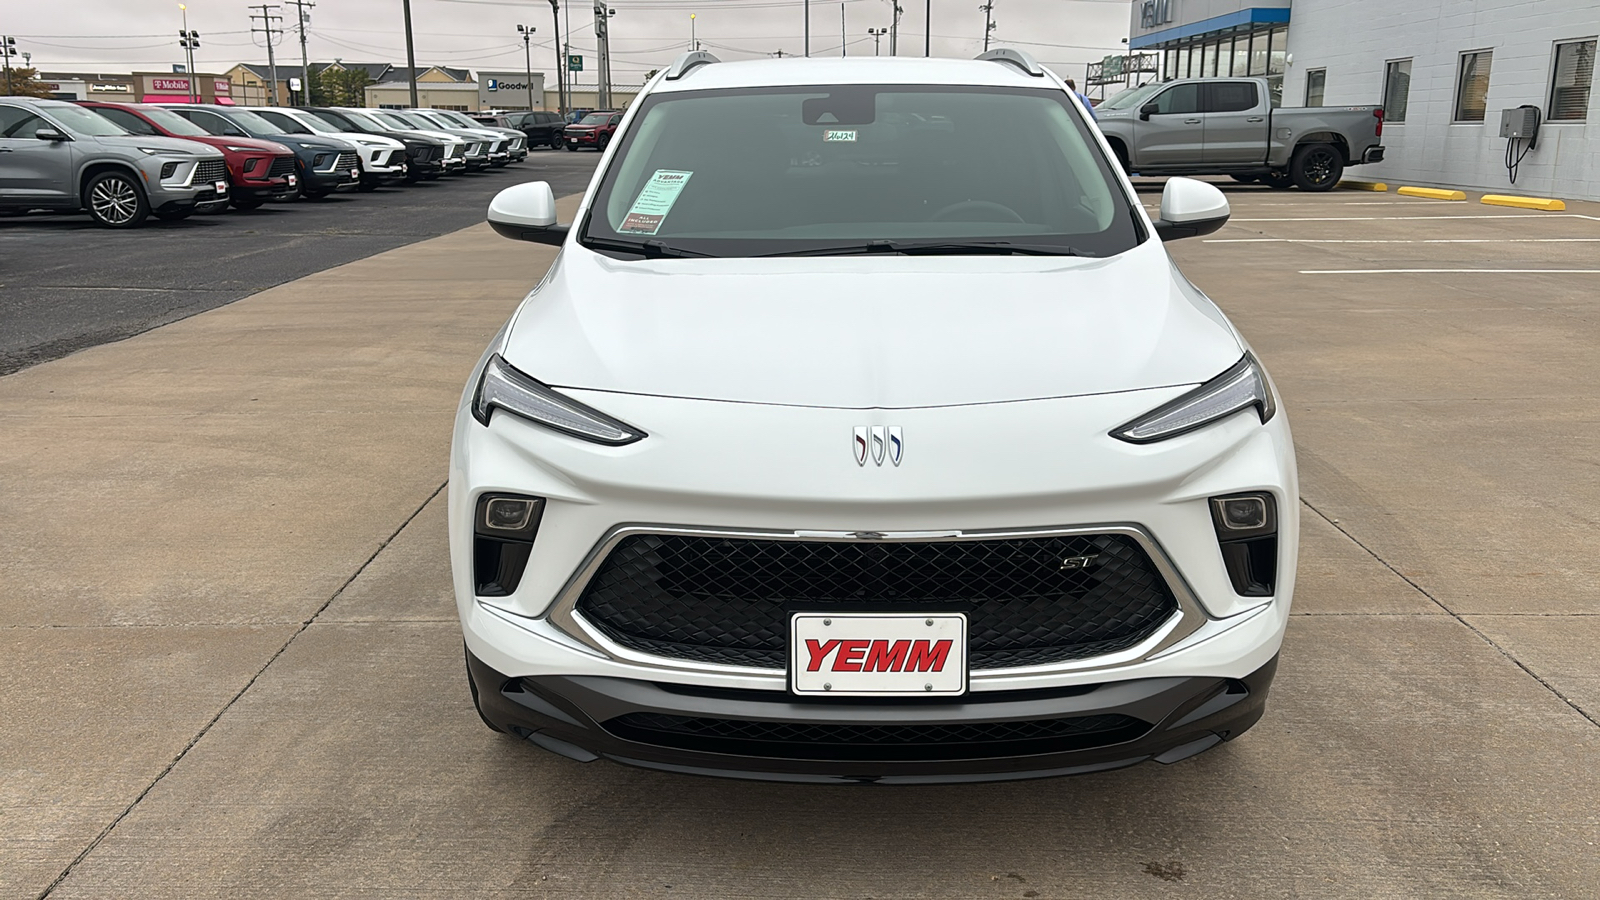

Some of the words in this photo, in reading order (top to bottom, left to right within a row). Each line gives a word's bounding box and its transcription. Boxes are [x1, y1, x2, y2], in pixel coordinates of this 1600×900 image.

[162, 81, 188, 89] Mobile
[498, 82, 534, 90] Goodwl
[1060, 554, 1099, 570] ST
[805, 639, 953, 673] YEMM
